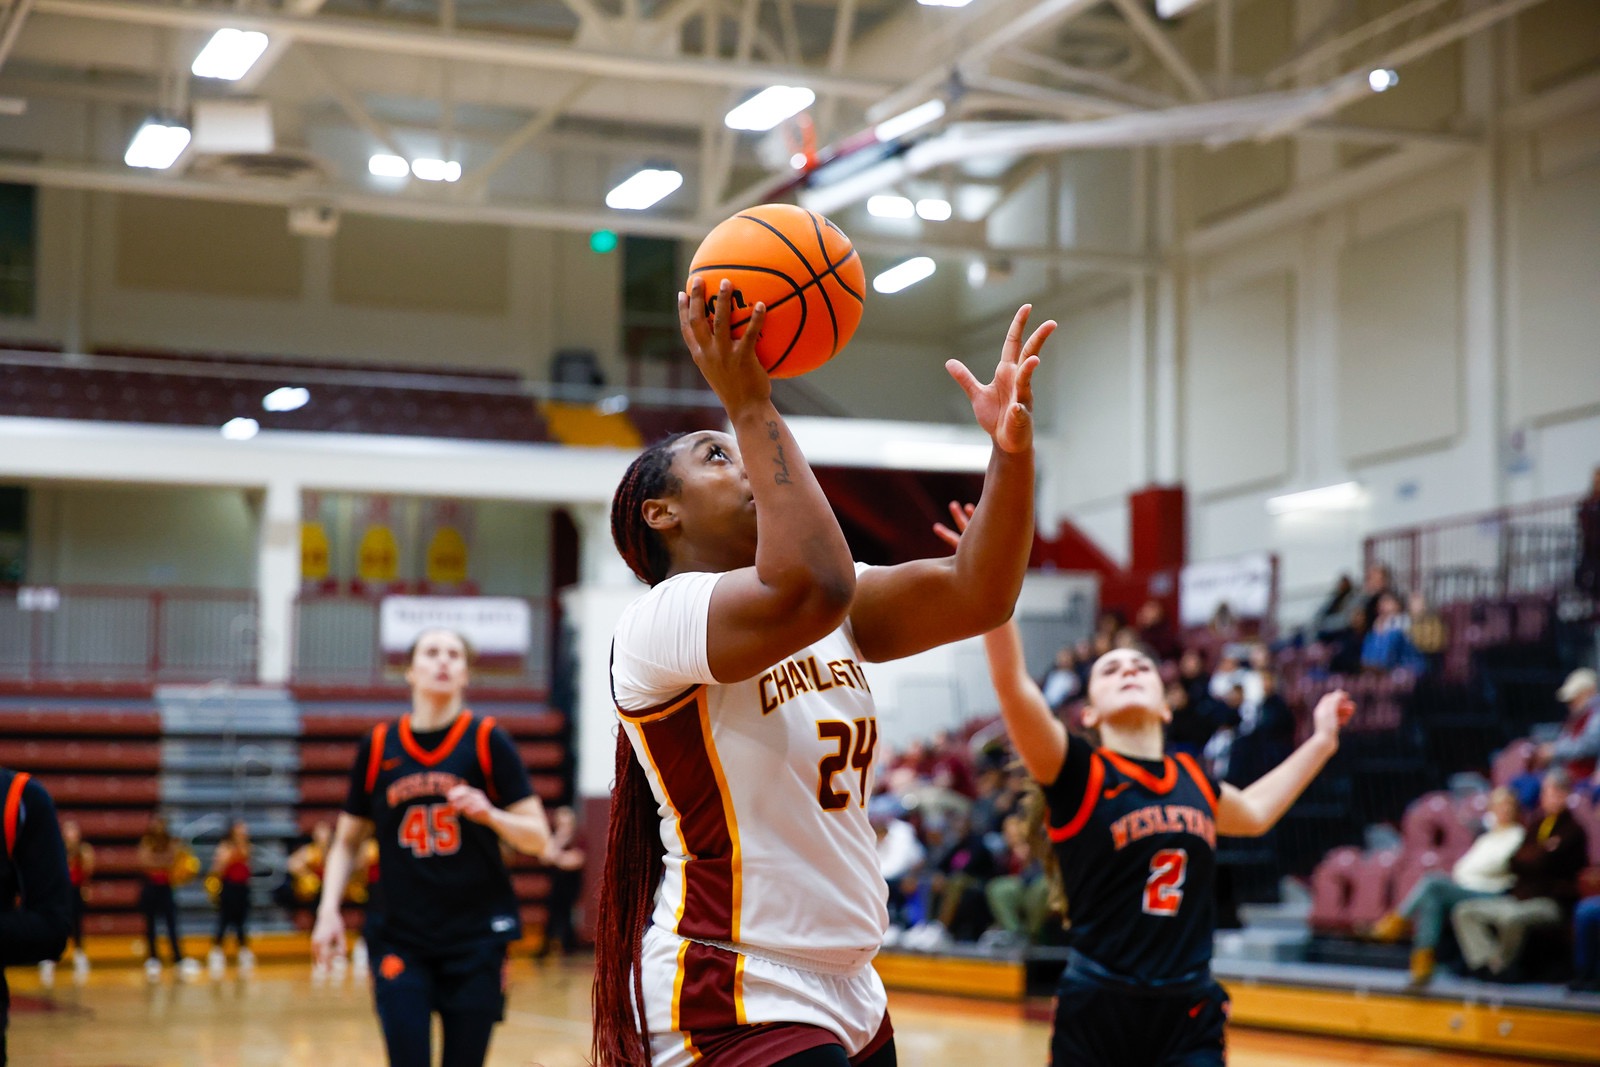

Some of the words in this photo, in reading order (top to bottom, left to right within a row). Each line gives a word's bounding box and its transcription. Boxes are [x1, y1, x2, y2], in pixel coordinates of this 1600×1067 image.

[815, 716, 878, 812] 24
[398, 803, 462, 858] 45
[1142, 847, 1190, 917] 2
